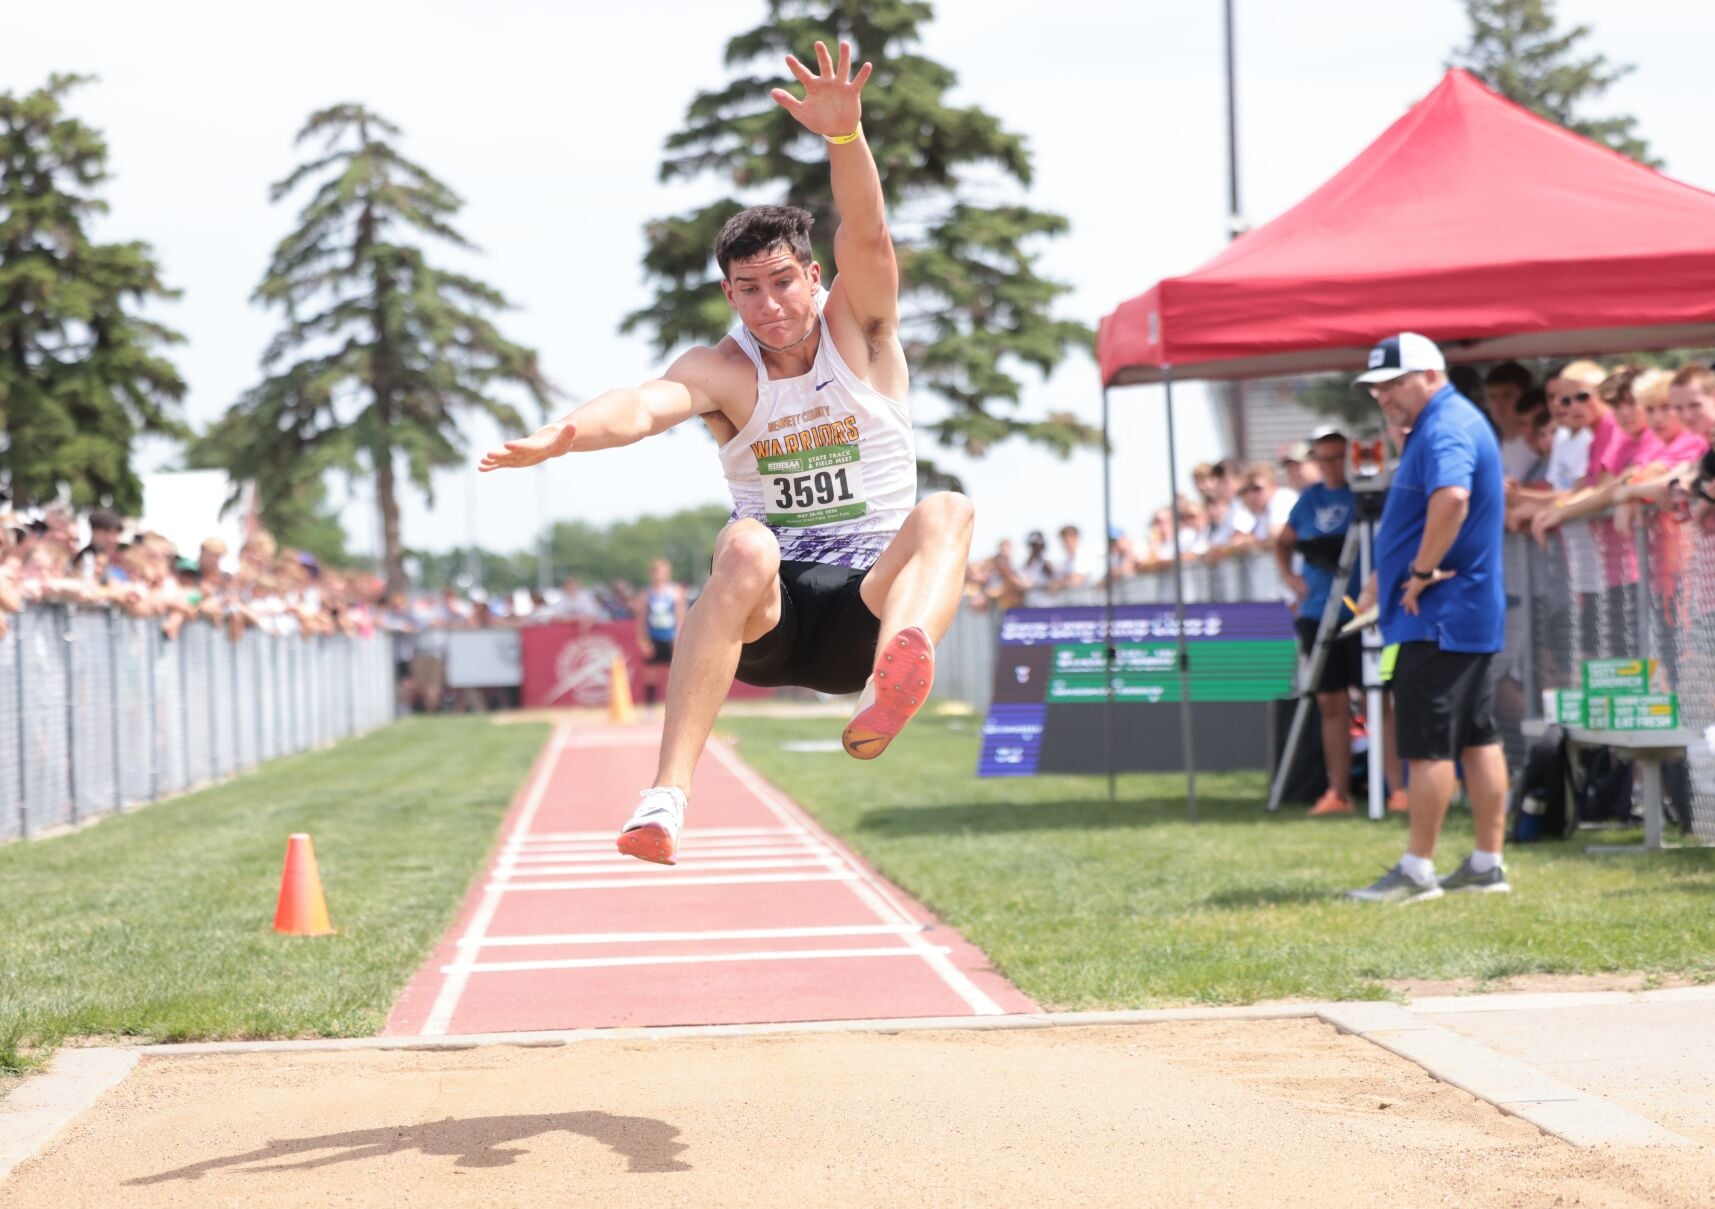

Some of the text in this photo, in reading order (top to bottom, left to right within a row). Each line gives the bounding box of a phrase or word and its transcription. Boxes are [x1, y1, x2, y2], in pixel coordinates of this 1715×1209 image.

[801, 405, 830, 422] COUNTY
[750, 415, 859, 459] WARRIORS
[808, 450, 851, 463] STATE TRACK
[815, 459, 833, 468] FIELD
[835, 455, 852, 465] MEET
[773, 468, 854, 509] 3591
